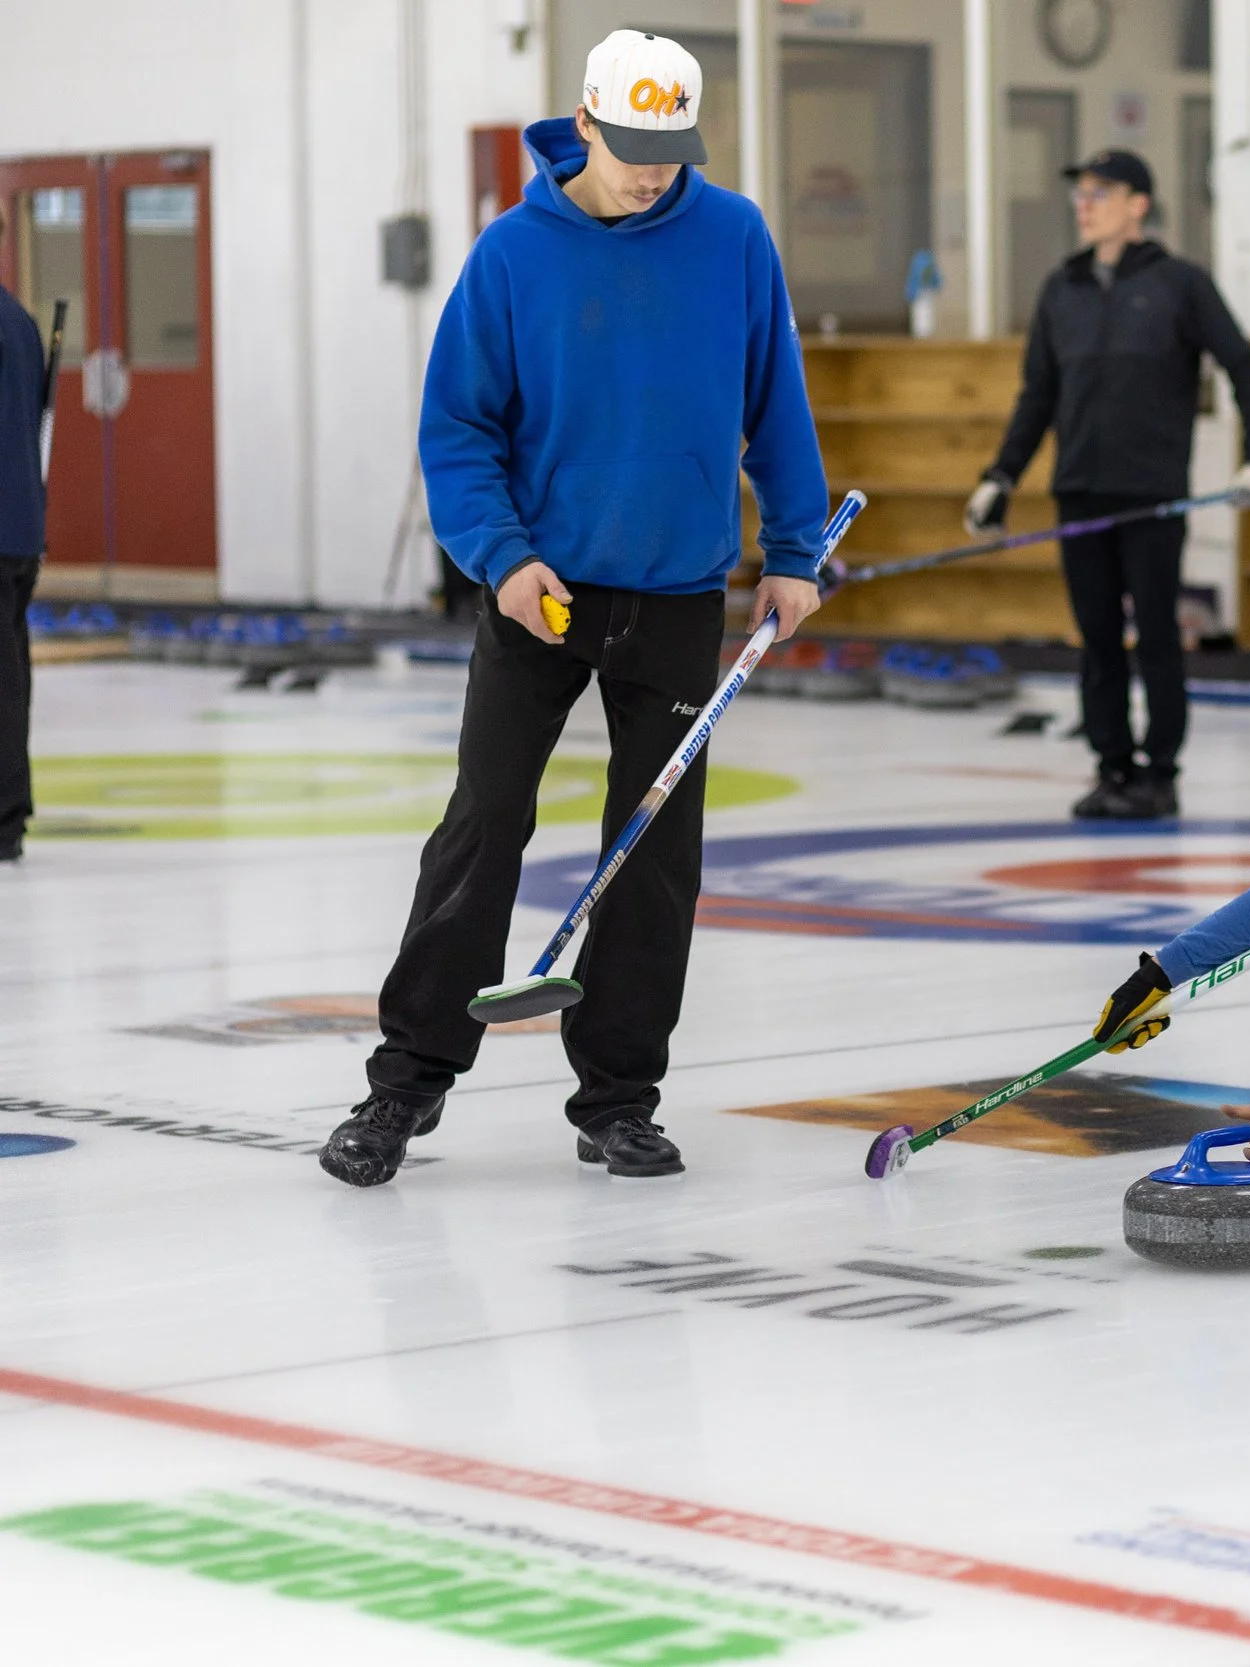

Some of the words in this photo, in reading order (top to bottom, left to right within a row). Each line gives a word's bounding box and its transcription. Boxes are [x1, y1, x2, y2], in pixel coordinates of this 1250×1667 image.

[680, 722, 711, 766] BRITISH
[708, 673, 745, 728] COLUMBIA
[974, 1072, 1043, 1115] Hardline
[555, 1252, 1076, 1334] HOYNE
[0, 1499, 789, 1667] EVERGREEN
